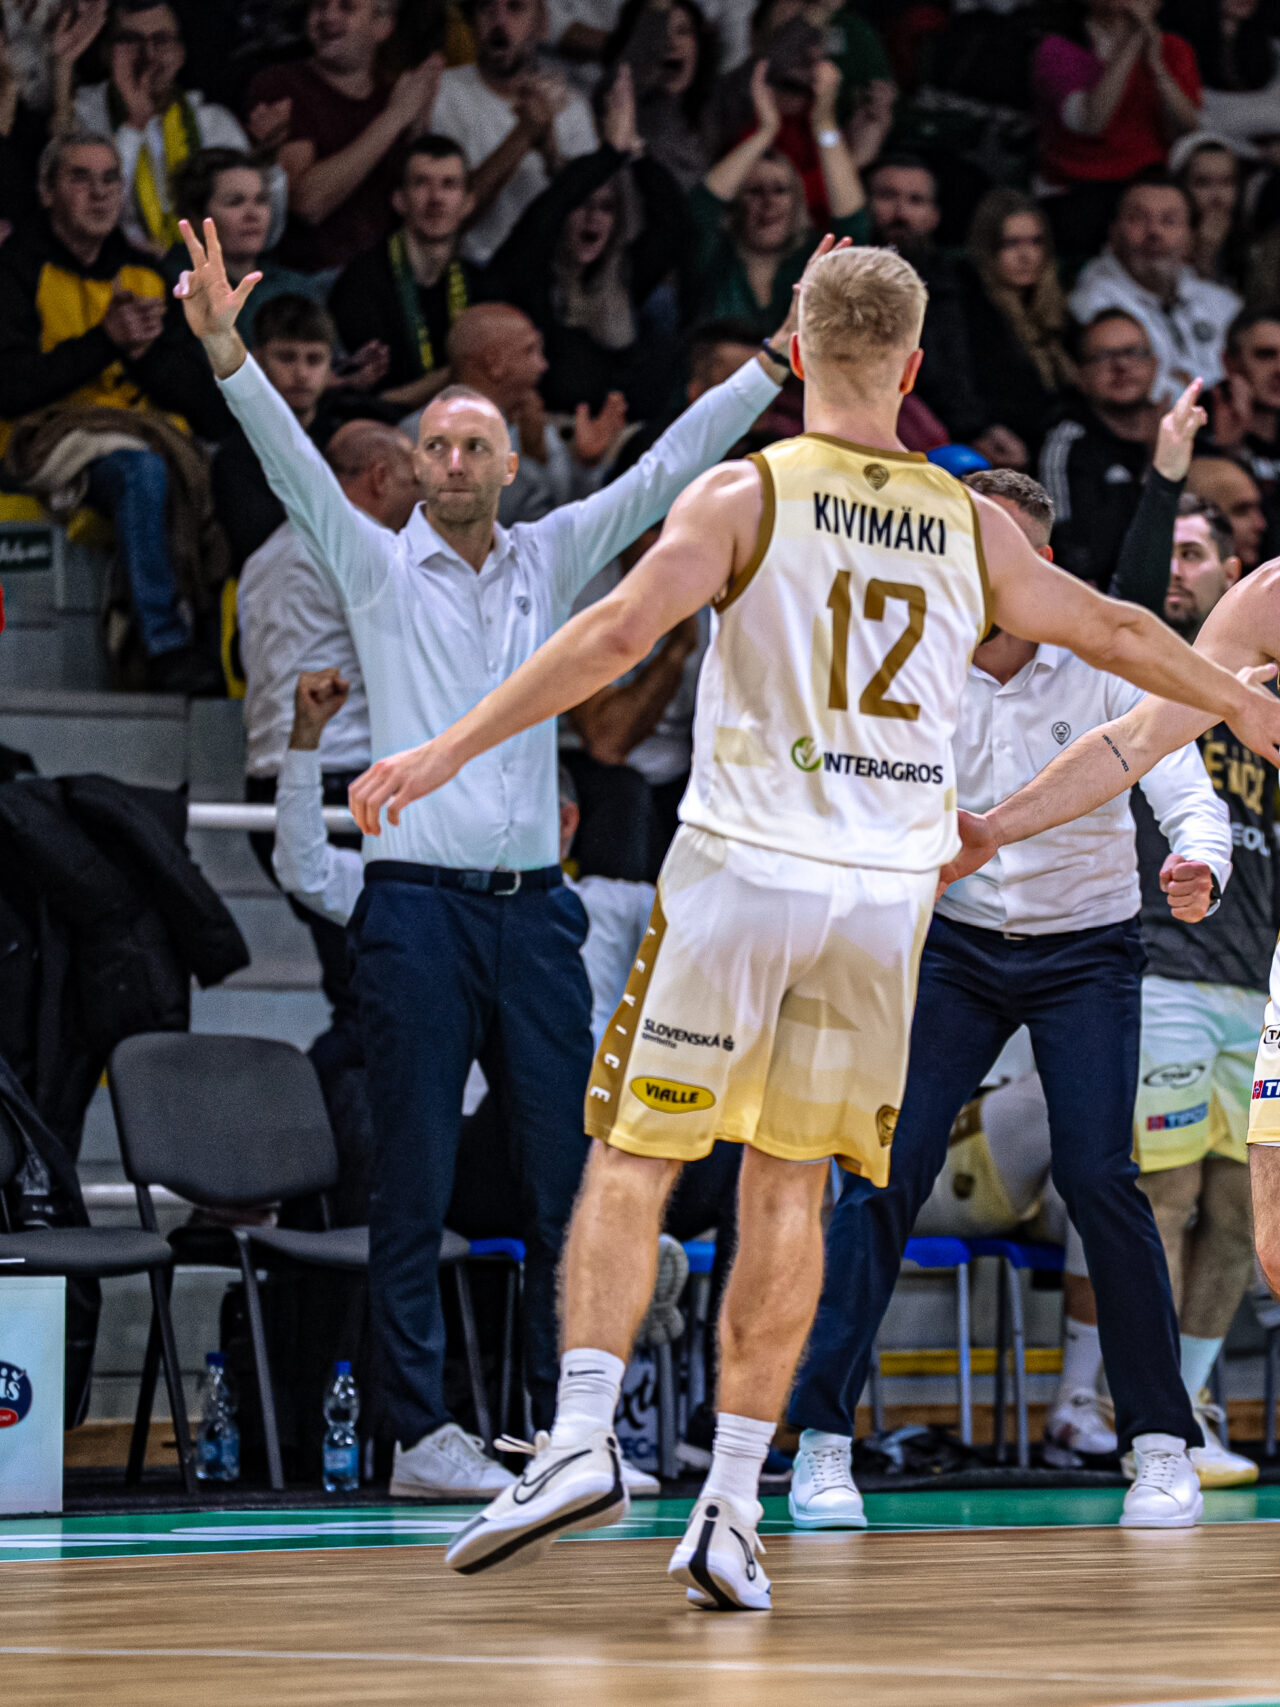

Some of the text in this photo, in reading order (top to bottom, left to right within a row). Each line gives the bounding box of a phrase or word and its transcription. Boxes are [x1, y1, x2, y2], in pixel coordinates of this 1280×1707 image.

[813, 491, 947, 556] KIVIMÄKI
[827, 569, 927, 722] 12
[823, 752, 944, 785] INTERAGROS
[643, 1018, 720, 1048] SLOVENSKÁ
[645, 1082, 700, 1105] VIALLE
